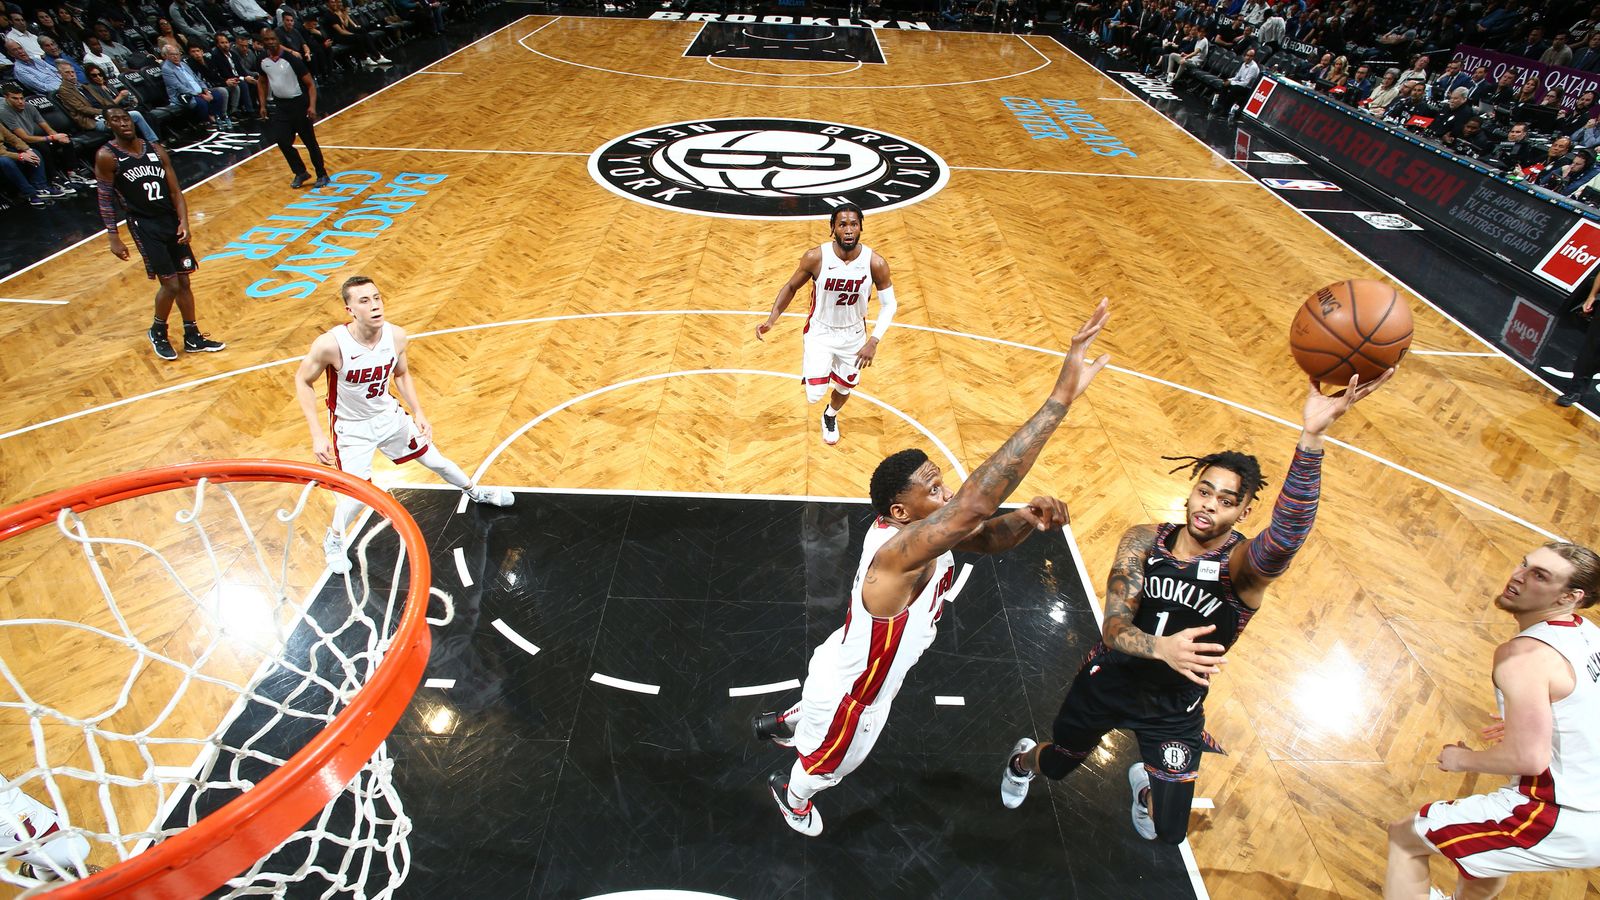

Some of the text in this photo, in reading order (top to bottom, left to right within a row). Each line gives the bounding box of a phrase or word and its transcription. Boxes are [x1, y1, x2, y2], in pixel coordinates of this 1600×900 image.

[648, 11, 932, 30] BROOKLYN
[1288, 40, 1318, 55] HONDA
[1493, 63, 1540, 84] QTA
[1000, 96, 1069, 140] CENTER
[1041, 98, 1138, 158] BARCLAYS
[627, 123, 716, 149] NEW
[820, 126, 931, 208] BROOKLYN
[1288, 104, 1384, 167] RICHARD
[1376, 149, 1404, 179] &
[1396, 159, 1467, 206] SON
[123, 165, 166, 183] BROOKLYN
[608, 156, 693, 201] YORK
[143, 181, 164, 201] 22
[1475, 186, 1496, 201] THE
[200, 170, 383, 262] CENTER
[1477, 204, 1544, 240] ELECTRONICS
[245, 172, 448, 298] BARCLAYS
[1449, 205, 1541, 256] & MATTRESS GIANT!
[1559, 240, 1597, 266] infor
[824, 275, 867, 292] HEAT
[836, 293, 860, 306] 20
[345, 357, 394, 384] HEAT
[1143, 576, 1223, 618] ROOKLYN
[1155, 611, 1170, 637] 1
